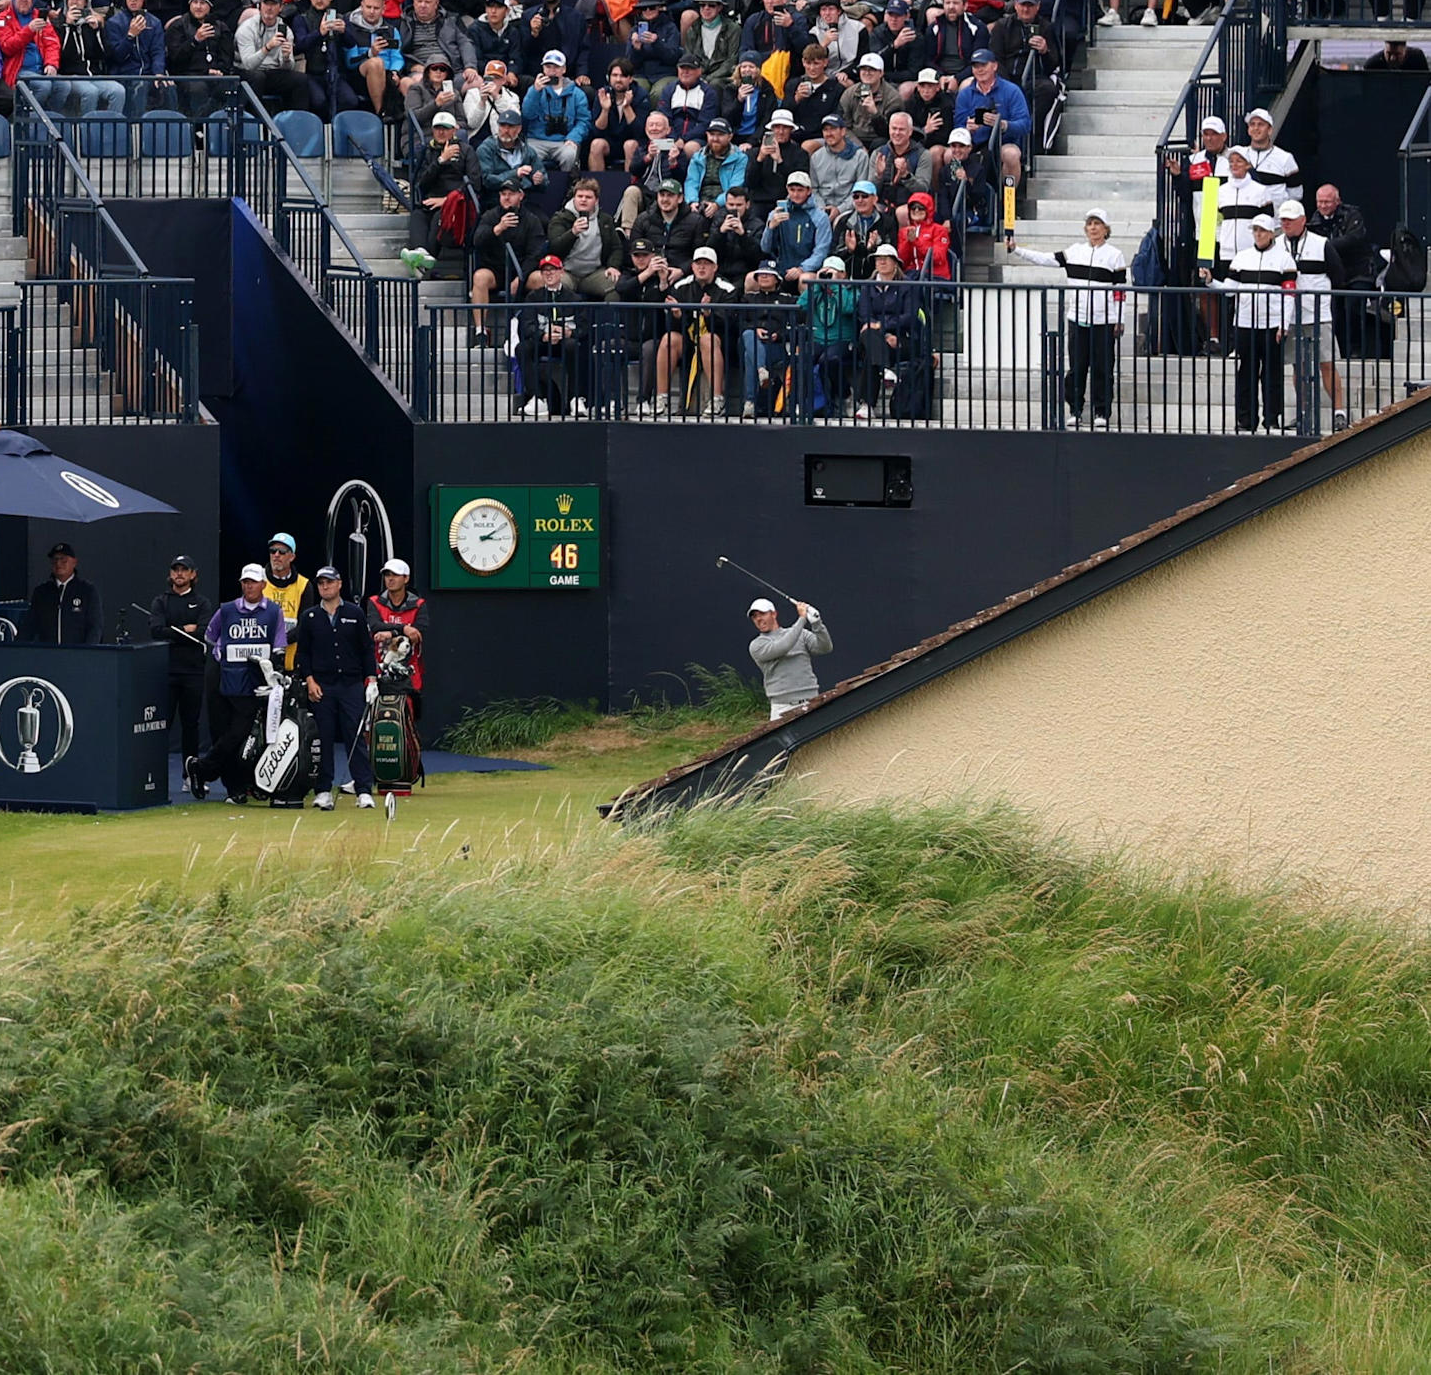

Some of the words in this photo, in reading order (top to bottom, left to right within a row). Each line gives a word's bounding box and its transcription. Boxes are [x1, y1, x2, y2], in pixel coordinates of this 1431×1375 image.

[534, 518, 595, 532] ROLEX
[549, 543, 579, 569] 46
[549, 575, 580, 585] GAME
[272, 591, 286, 601] THE
[240, 618, 257, 626] THE
[228, 624, 268, 639] OPEN
[234, 647, 263, 658] THOMAS
[258, 732, 295, 787] Titleist
